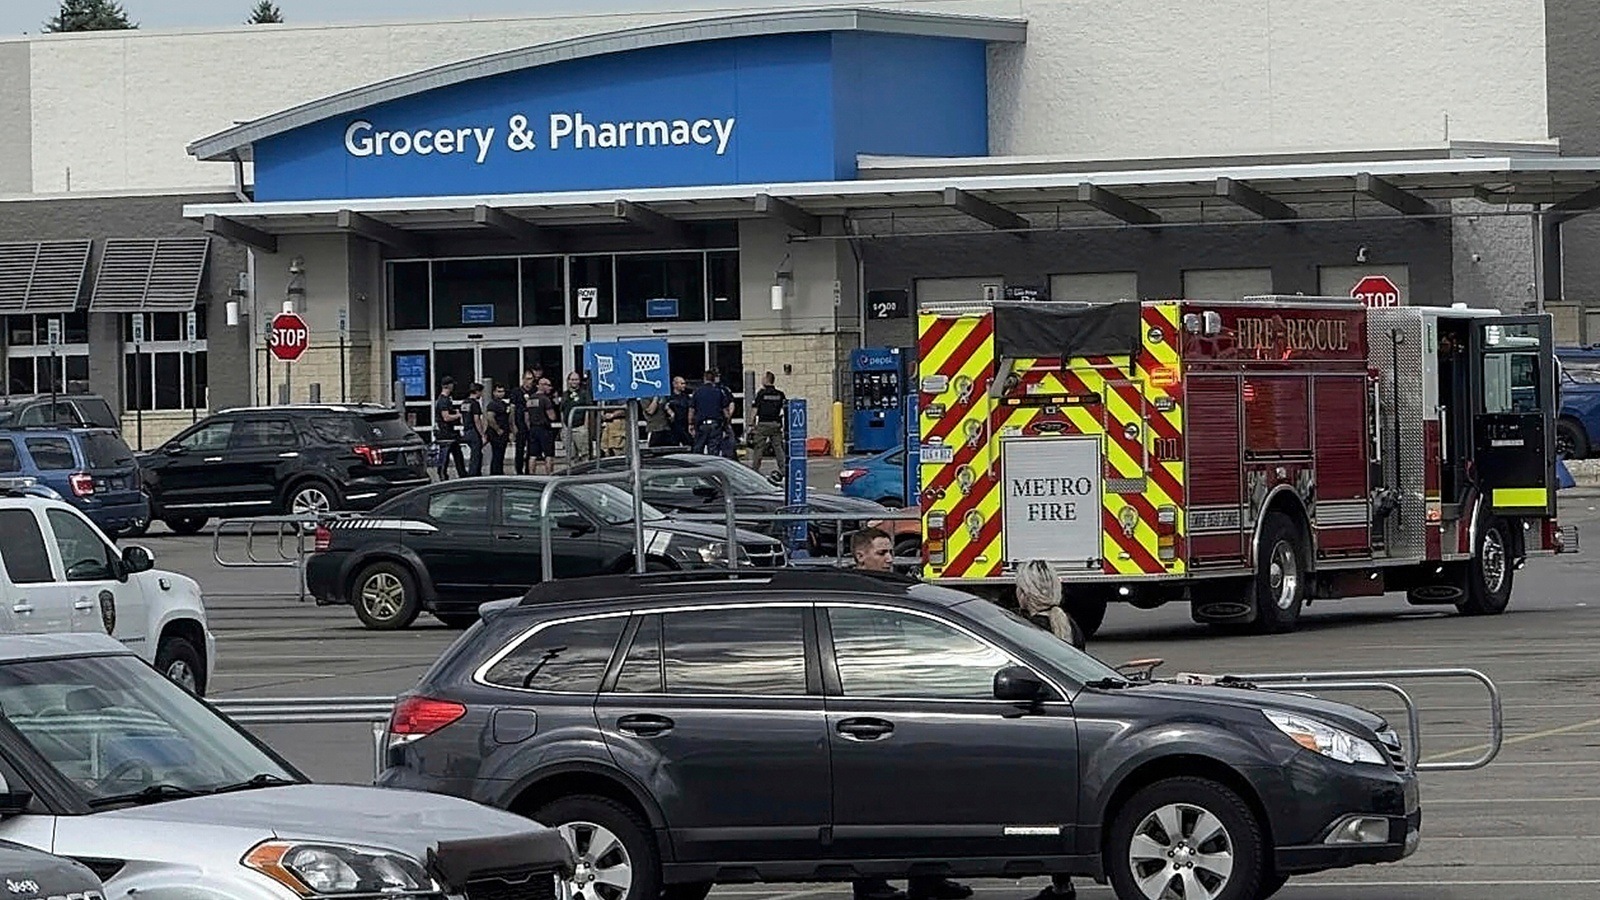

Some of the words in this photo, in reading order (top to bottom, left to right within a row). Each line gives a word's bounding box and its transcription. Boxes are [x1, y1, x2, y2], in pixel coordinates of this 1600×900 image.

[344, 120, 495, 163] Grocery
[506, 114, 536, 152] &
[549, 113, 735, 155] Pharmacy
[581, 297, 593, 317] 7
[270, 328, 306, 347] STOP
[1236, 317, 1274, 350] FIRE
[1286, 318, 1348, 350] RESCUE
[791, 408, 805, 428] 20
[1012, 477, 1092, 498] METRO
[1027, 502, 1078, 522] FIRE
[6, 878, 41, 894] Jeep
